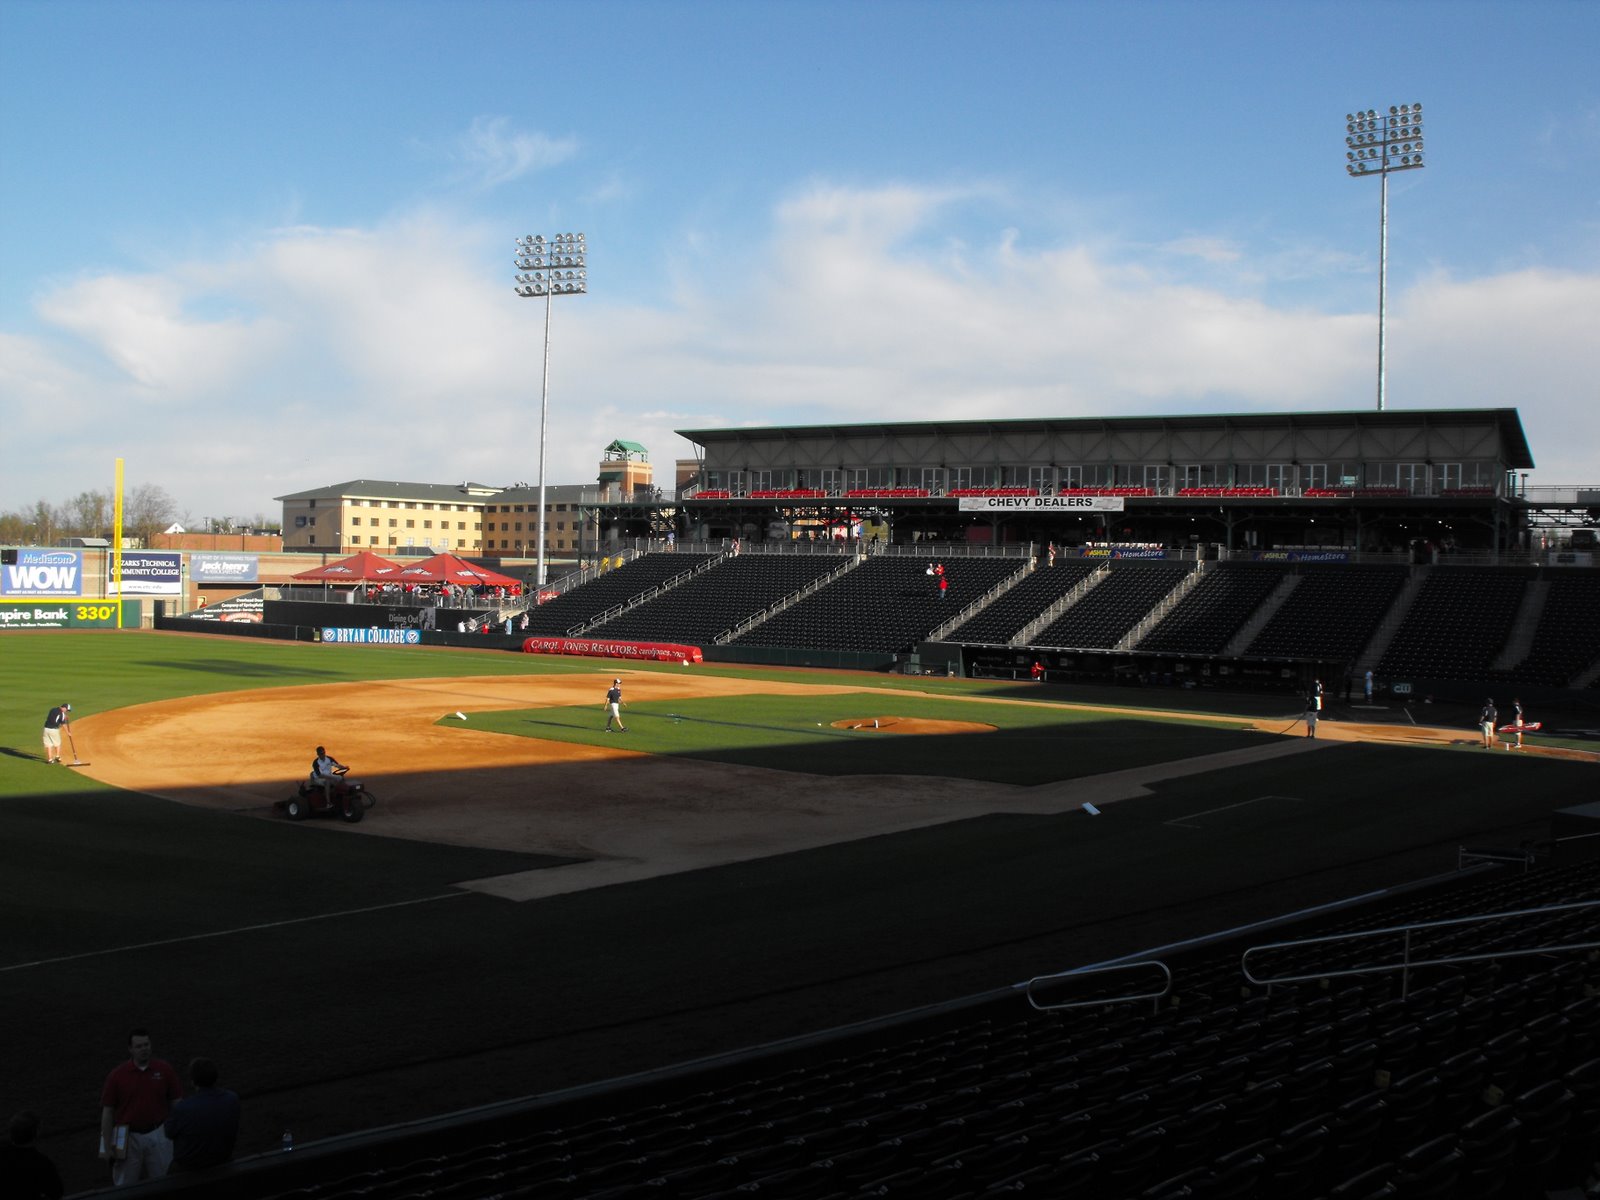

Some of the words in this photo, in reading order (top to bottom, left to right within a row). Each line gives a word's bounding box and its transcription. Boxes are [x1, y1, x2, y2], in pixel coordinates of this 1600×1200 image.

[988, 498, 1031, 507] CHEVY
[1034, 498, 1093, 507] DEALERS
[23, 554, 73, 564] Mediacom
[140, 559, 176, 567] TECHNICAL
[151, 567, 180, 576] COLLEGE
[8, 566, 77, 589] WOW
[34, 608, 68, 620] Bank
[388, 613, 407, 624] Dining
[408, 614, 419, 623] Out
[337, 628, 365, 643] BRYAN
[368, 629, 405, 643] COLLEGE
[531, 639, 559, 650] CAROL
[562, 640, 589, 652] JONES
[591, 643, 638, 655] REALTORS
